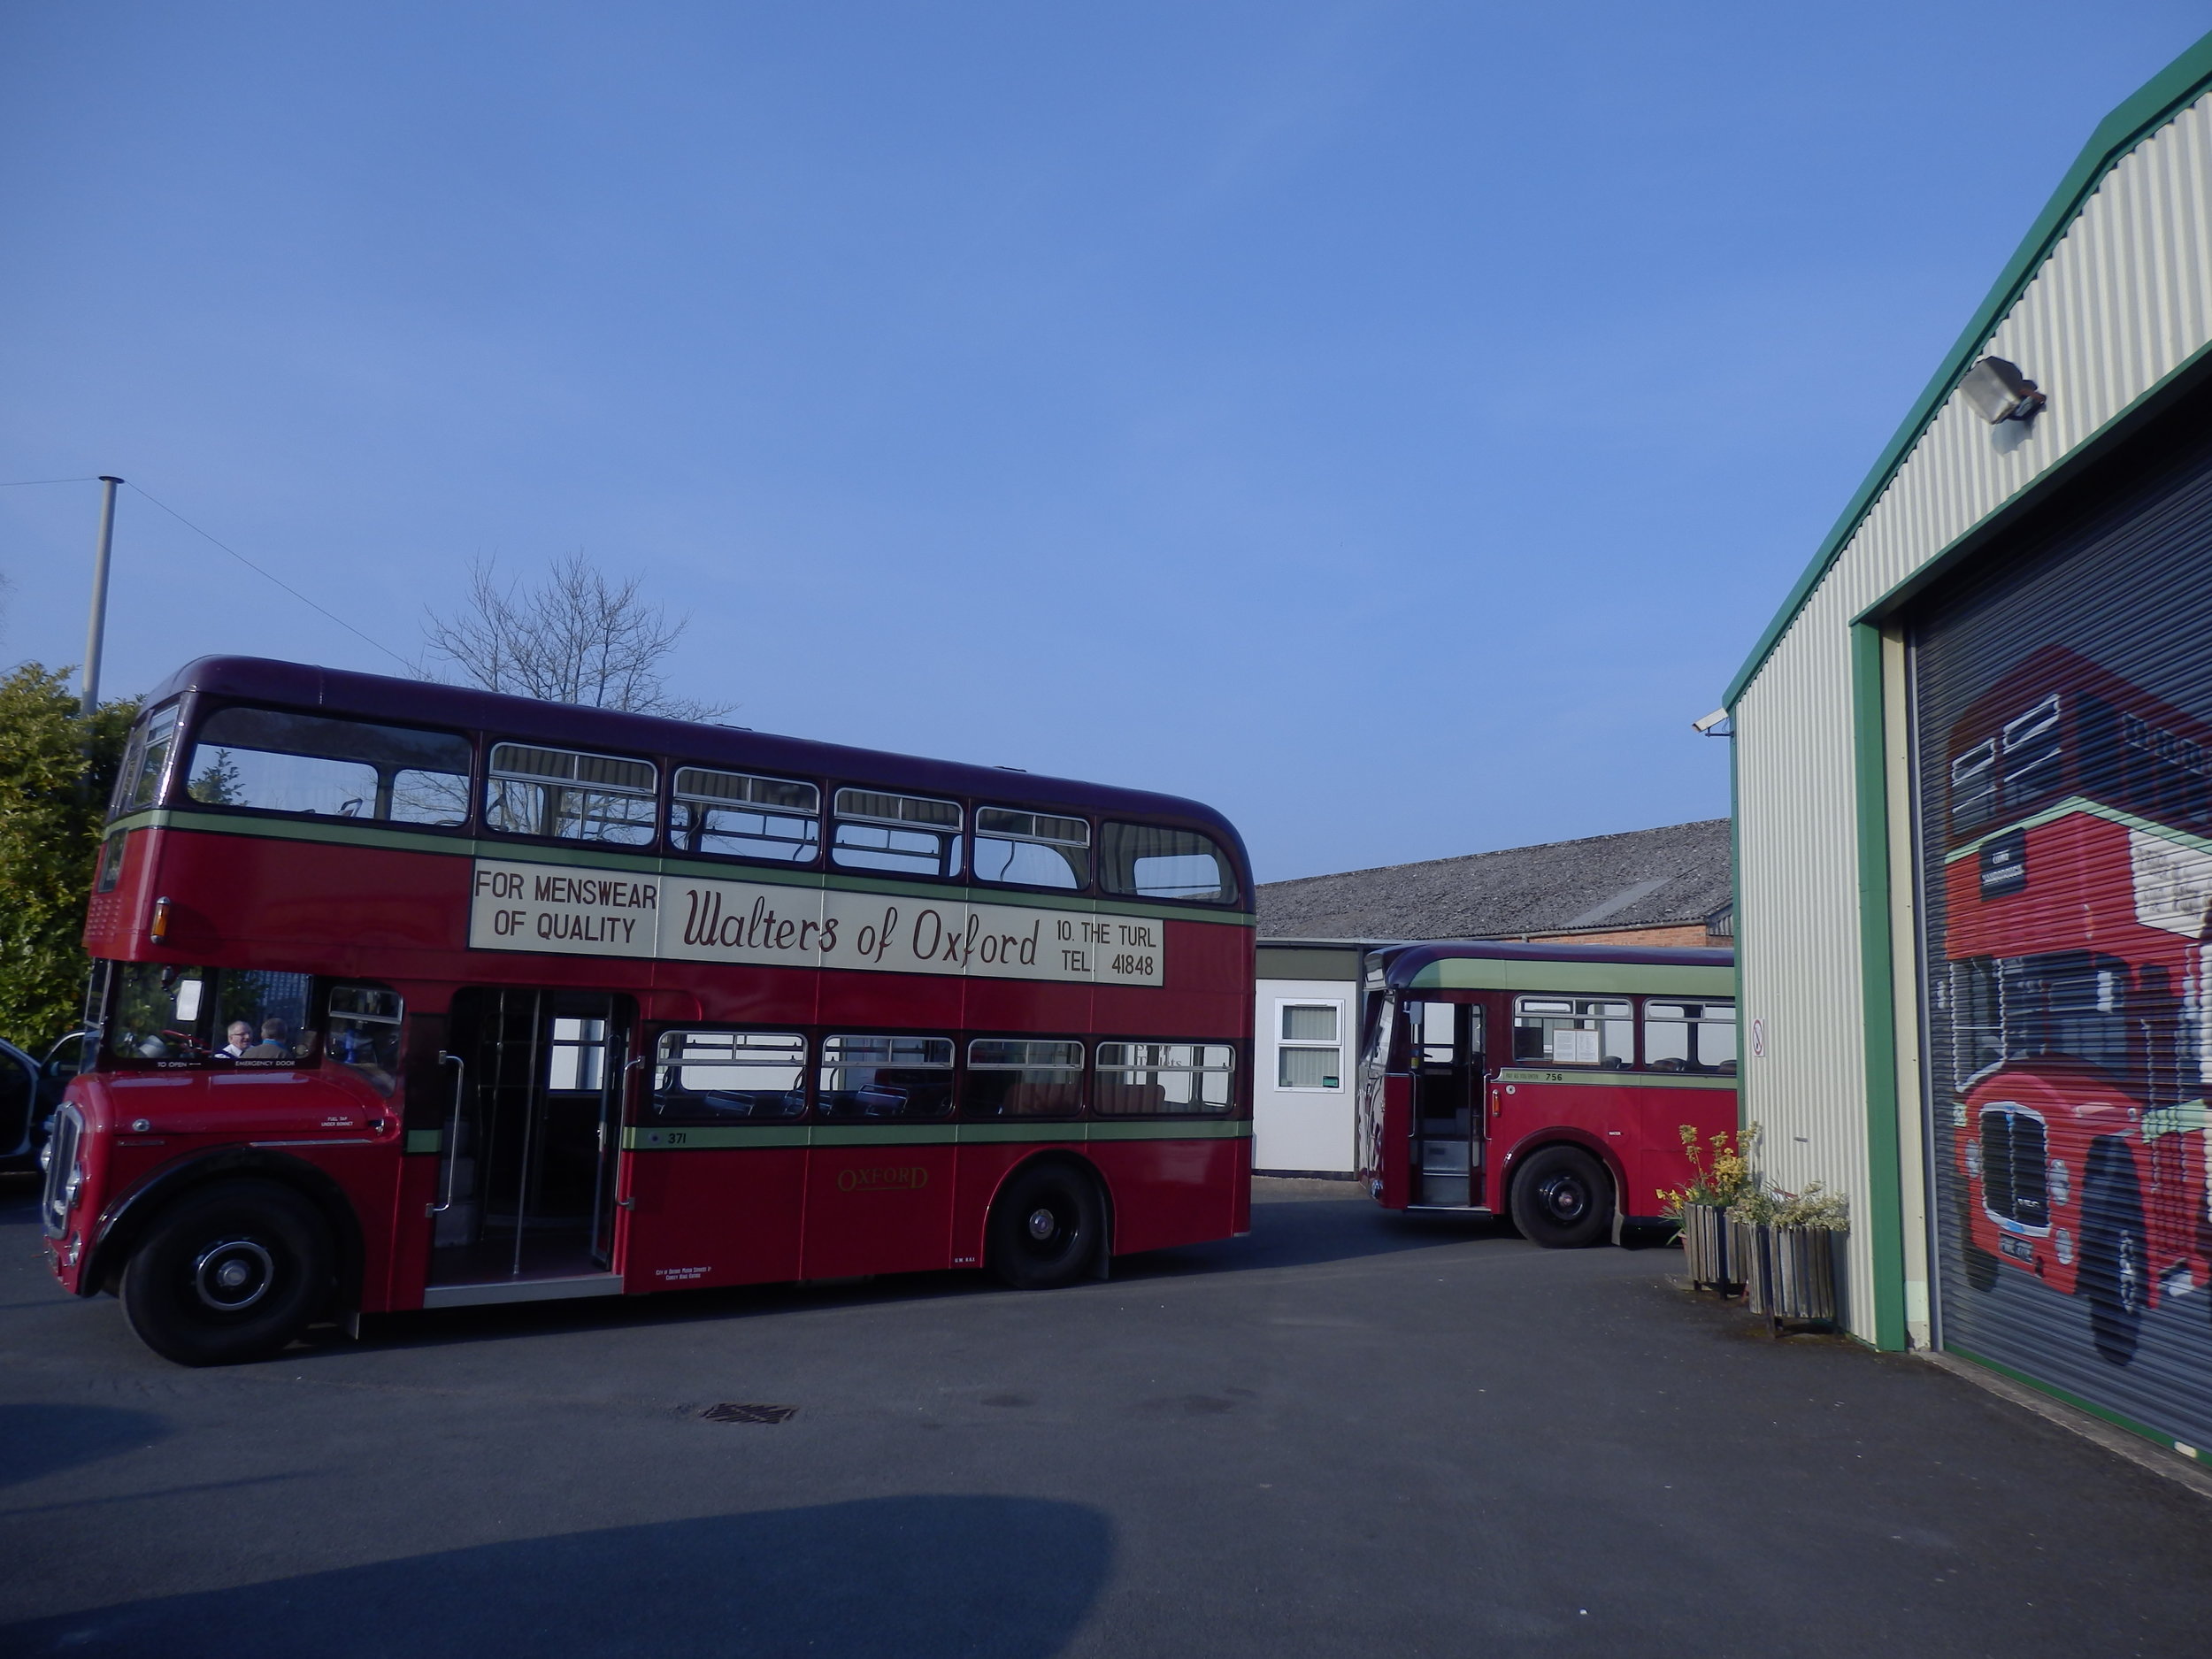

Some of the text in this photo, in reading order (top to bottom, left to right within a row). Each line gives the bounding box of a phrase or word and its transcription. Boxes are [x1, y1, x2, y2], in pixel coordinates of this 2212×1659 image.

[474, 870, 657, 910] FOR MENSWEAR
[494, 909, 636, 944] OF QUALITY
[683, 889, 1041, 968] Walters of Oxford
[1081, 921, 1110, 945] THE
[1118, 925, 1156, 948] TURL
[1111, 953, 1155, 977] 41848
[668, 1133, 687, 1144] 371
[837, 1167, 928, 1192] OXFORD
